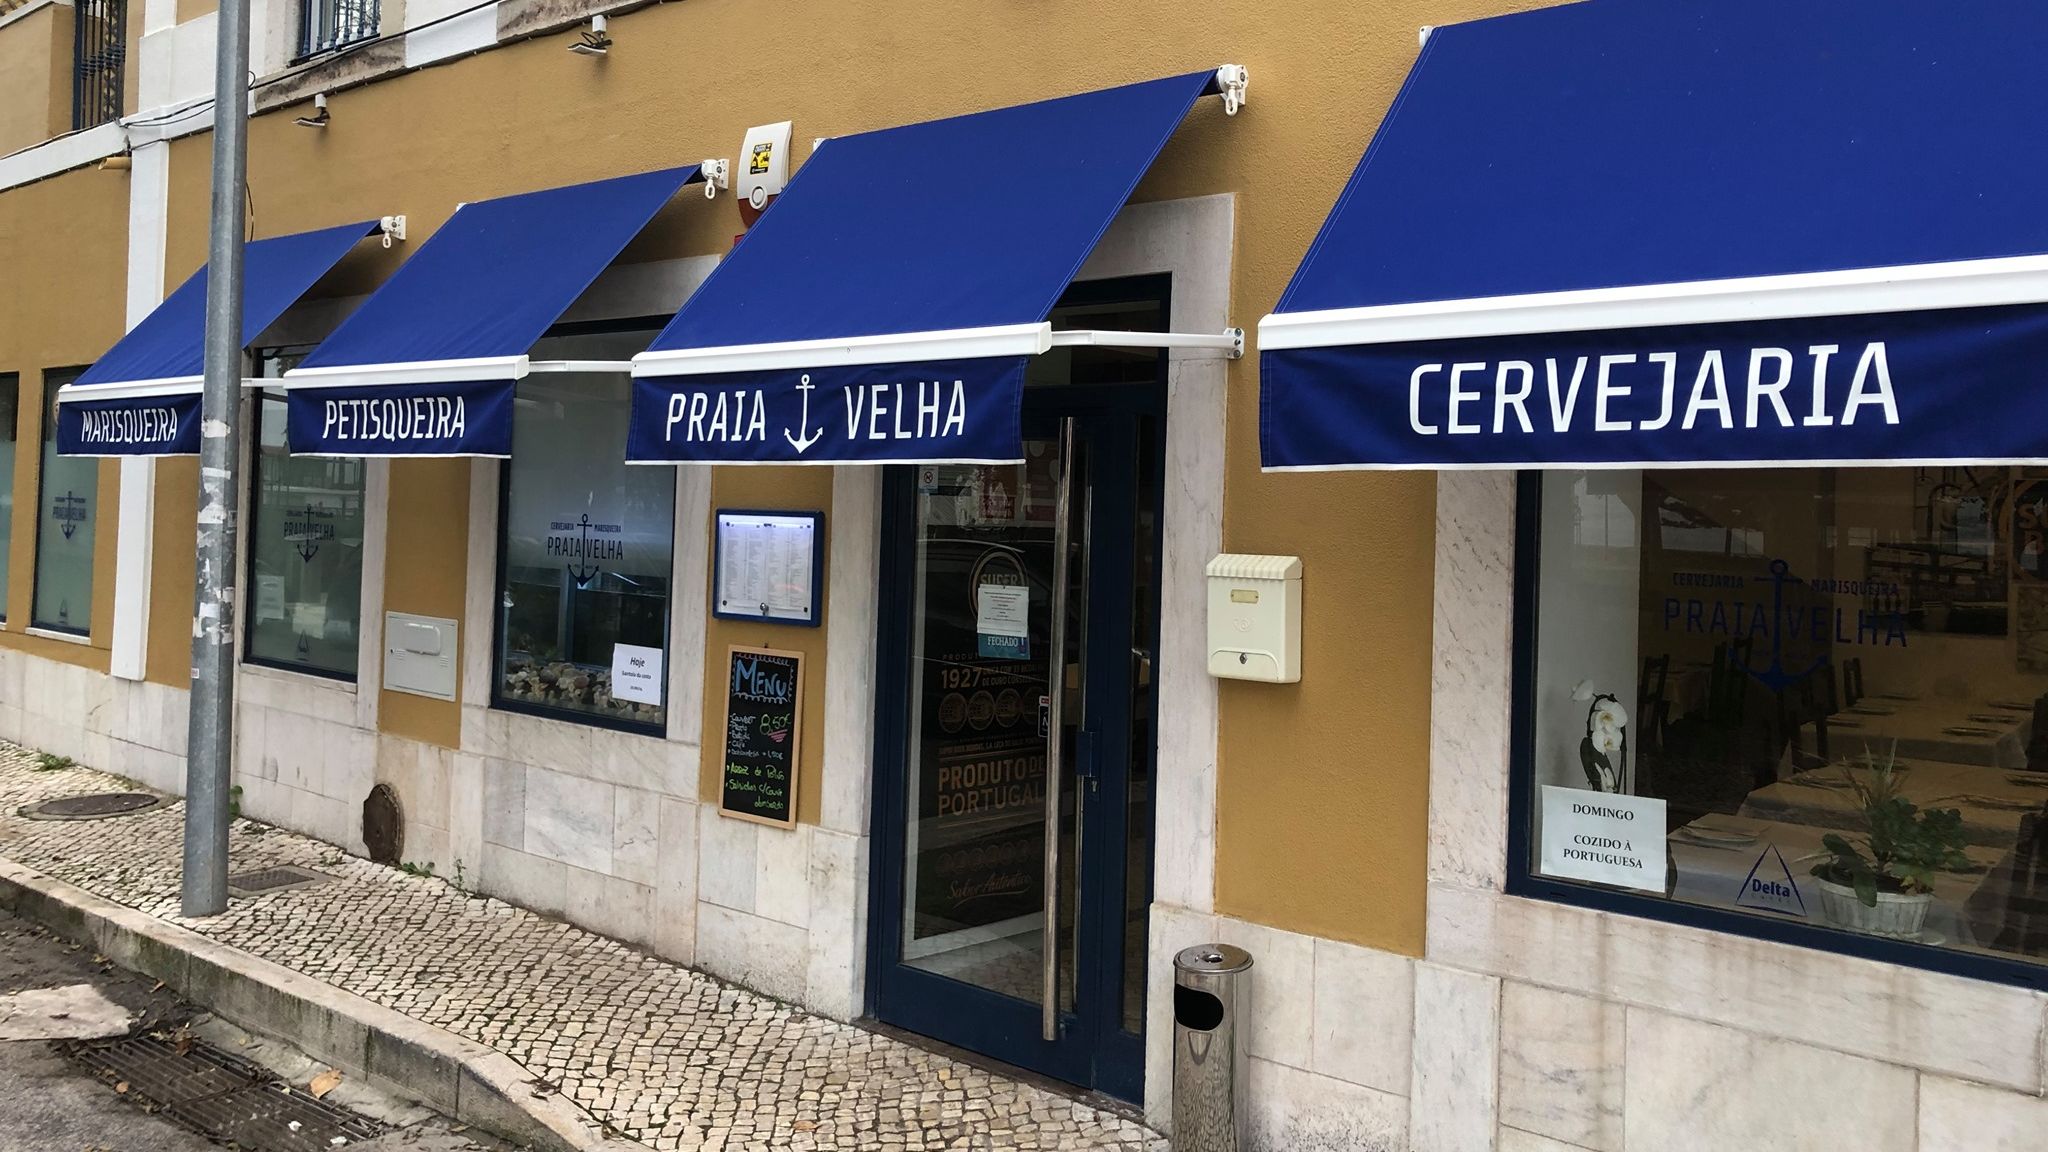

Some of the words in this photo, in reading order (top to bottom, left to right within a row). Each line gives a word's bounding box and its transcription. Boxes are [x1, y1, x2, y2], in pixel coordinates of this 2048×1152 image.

[1410, 342, 1899, 435] CERVEJARIA
[322, 396, 465, 441] PETISQUEIRA
[666, 390, 766, 442] PRAIA
[845, 380, 966, 440] VELHA
[81, 408, 178, 444] MARISQUEIRA
[547, 536, 582, 557] PRAIA
[586, 538, 624, 560] VELHA
[1672, 572, 1744, 590] CERVEJARIA
[1810, 578, 1899, 596] MARISQUEIRA
[1663, 598, 1769, 640] PRAIA
[1785, 603, 1908, 648] VELHA
[987, 635, 1020, 647] FECHADO
[630, 656, 645, 668] Hoje
[941, 667, 982, 689] 1927
[938, 758, 1027, 793] PRODUTO
[938, 781, 1041, 818] PORTUGAL
[1573, 803, 1634, 821] DOMINGO
[1573, 834, 1622, 850] COZIDO
[1624, 839, 1633, 852] À
[1563, 848, 1643, 869] PORTUGUESA
[1752, 878, 1790, 898] Delta
